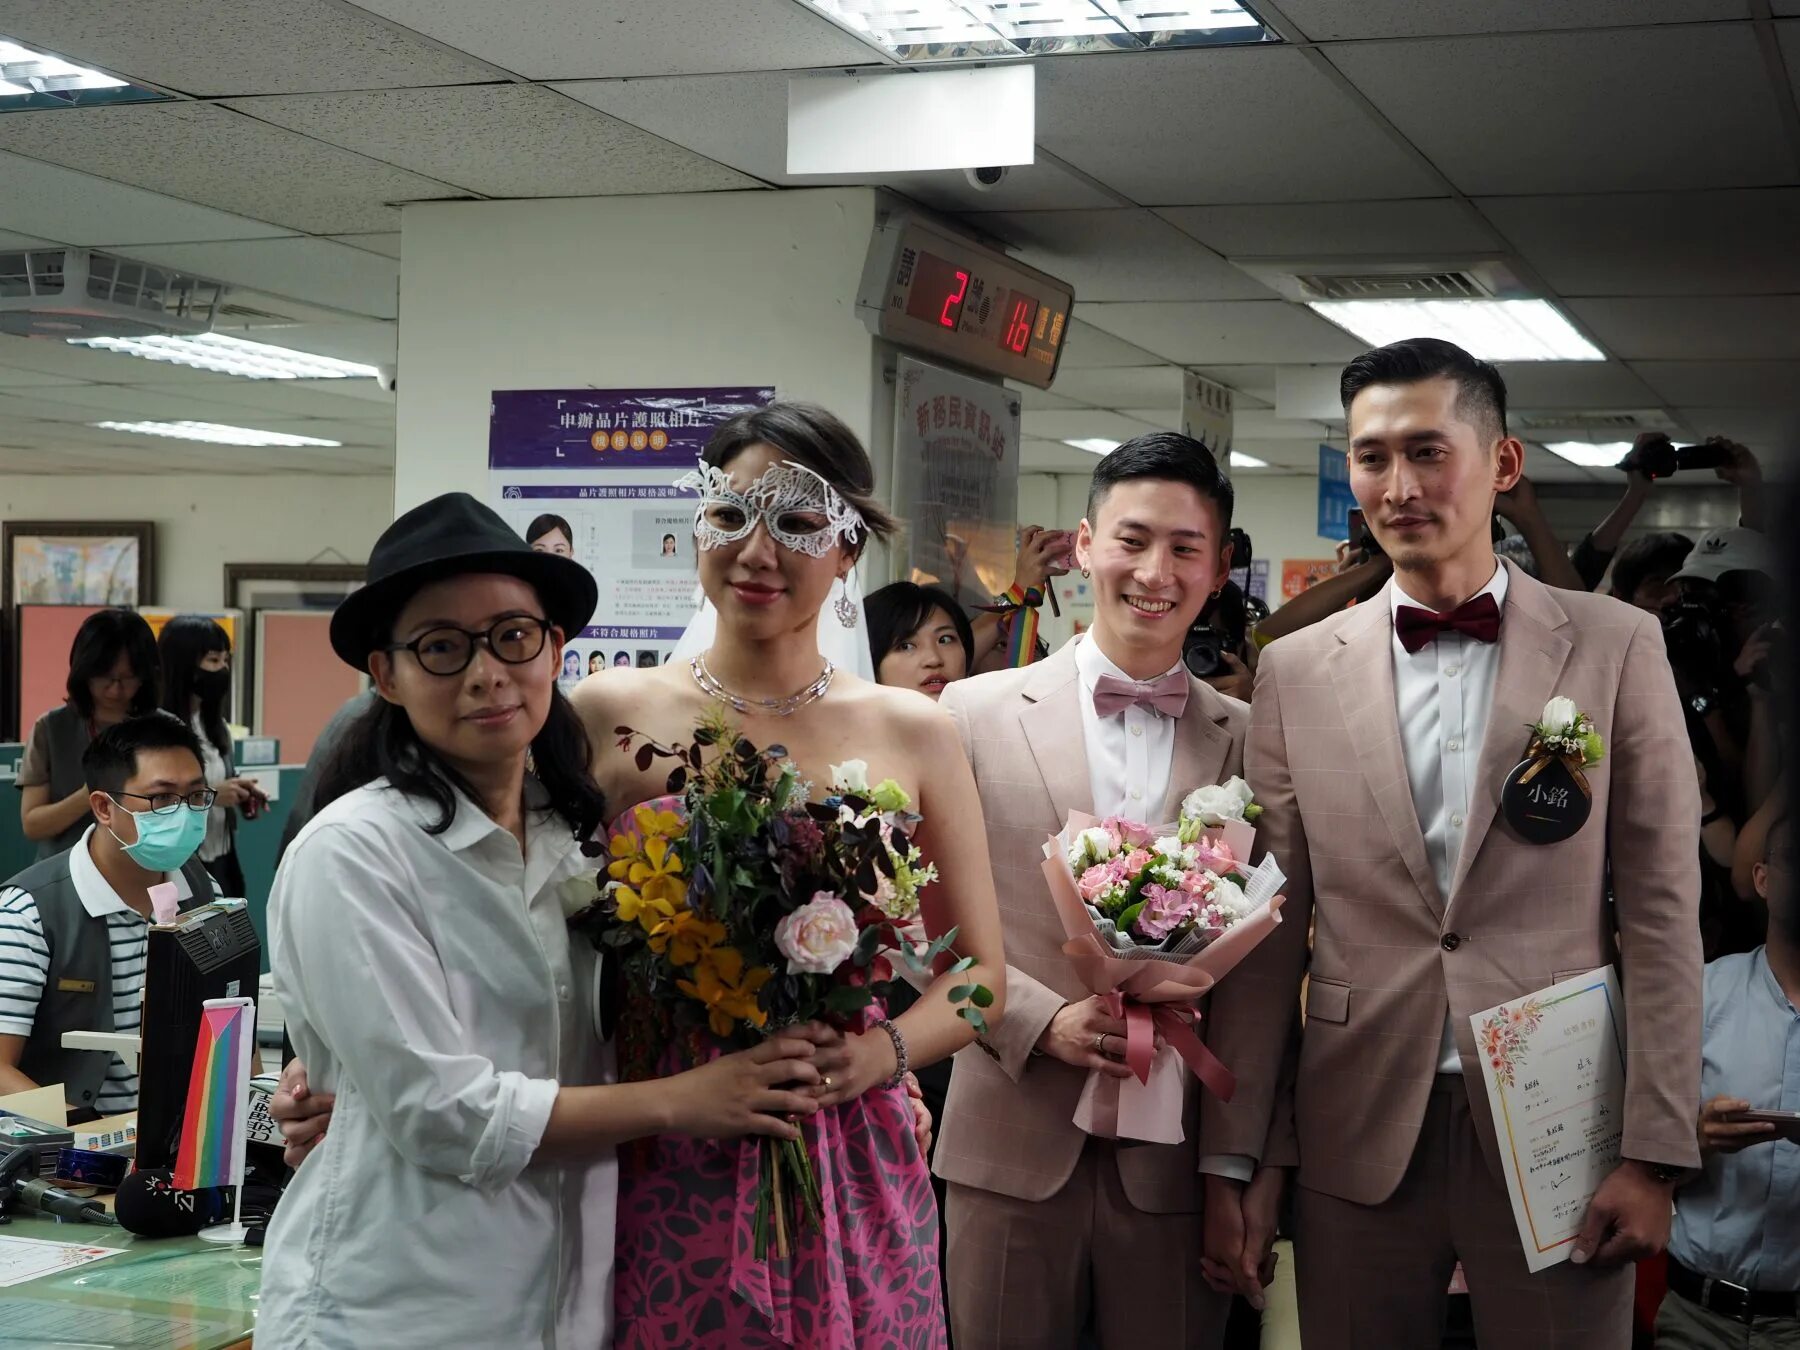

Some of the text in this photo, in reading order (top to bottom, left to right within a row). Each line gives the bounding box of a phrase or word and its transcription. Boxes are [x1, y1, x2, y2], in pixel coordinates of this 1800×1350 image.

[939, 270, 968, 328] 2
[1005, 300, 1031, 353] 16
[559, 410, 701, 429] 申辦晶片護照相片
[578, 487, 678, 498] 晶片護照相片規格說明
[589, 627, 659, 638] 不符合規格照片
[1526, 783, 1570, 809] 小銘
